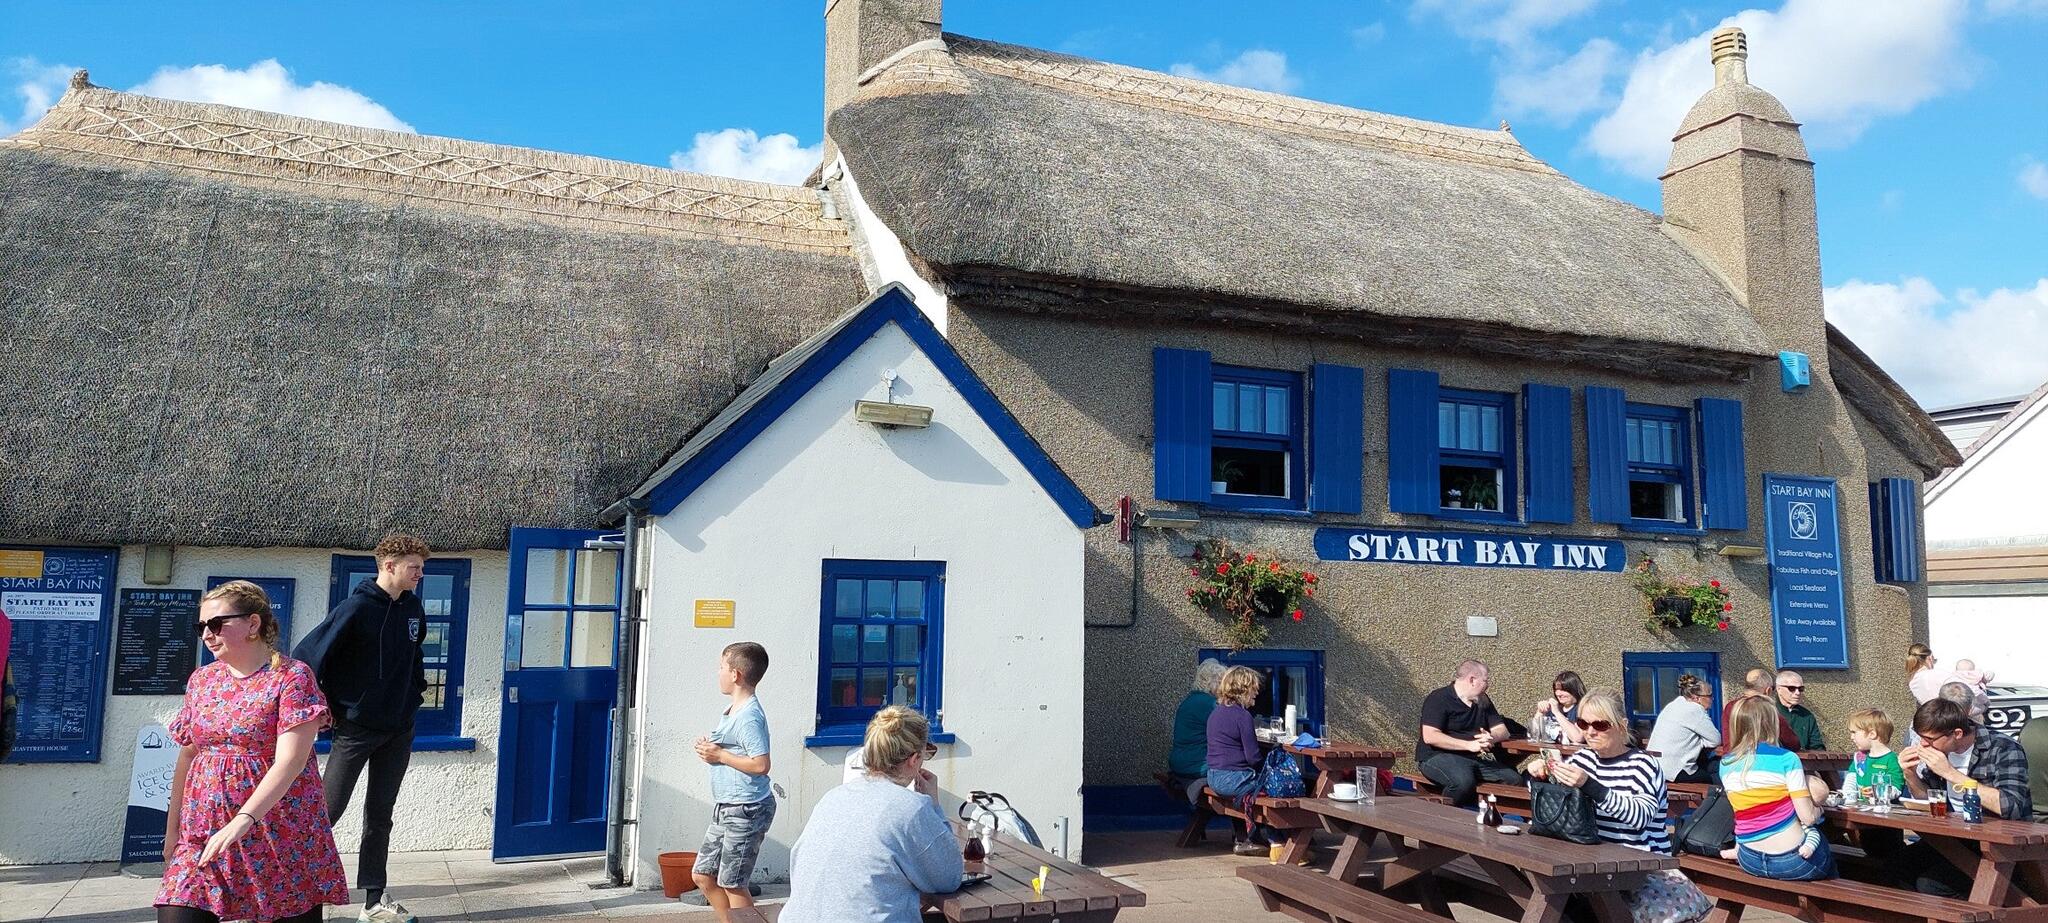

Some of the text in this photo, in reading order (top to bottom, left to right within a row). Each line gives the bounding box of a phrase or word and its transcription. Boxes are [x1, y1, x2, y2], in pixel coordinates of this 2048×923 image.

[1771, 484, 1831, 499] START BAY INN
[1348, 533, 1608, 569] START BAY INN
[1777, 549, 1804, 557] Traditional
[1804, 551, 1822, 559] Village
[1822, 568, 1838, 576] Chips
[2, 577, 102, 590] START BAY INN
[1804, 584, 1827, 592] Seafood
[130, 592, 155, 600] START
[159, 592, 175, 600] BAY
[1789, 601, 1813, 609] Extensive
[1784, 617, 1837, 627] Take Away Available
[1795, 635, 1812, 644] Family
[1987, 708, 2026, 729] 92
[137, 775, 160, 790] ICE
[144, 788, 157, 799] &
[128, 850, 165, 858] SALCOMBE
